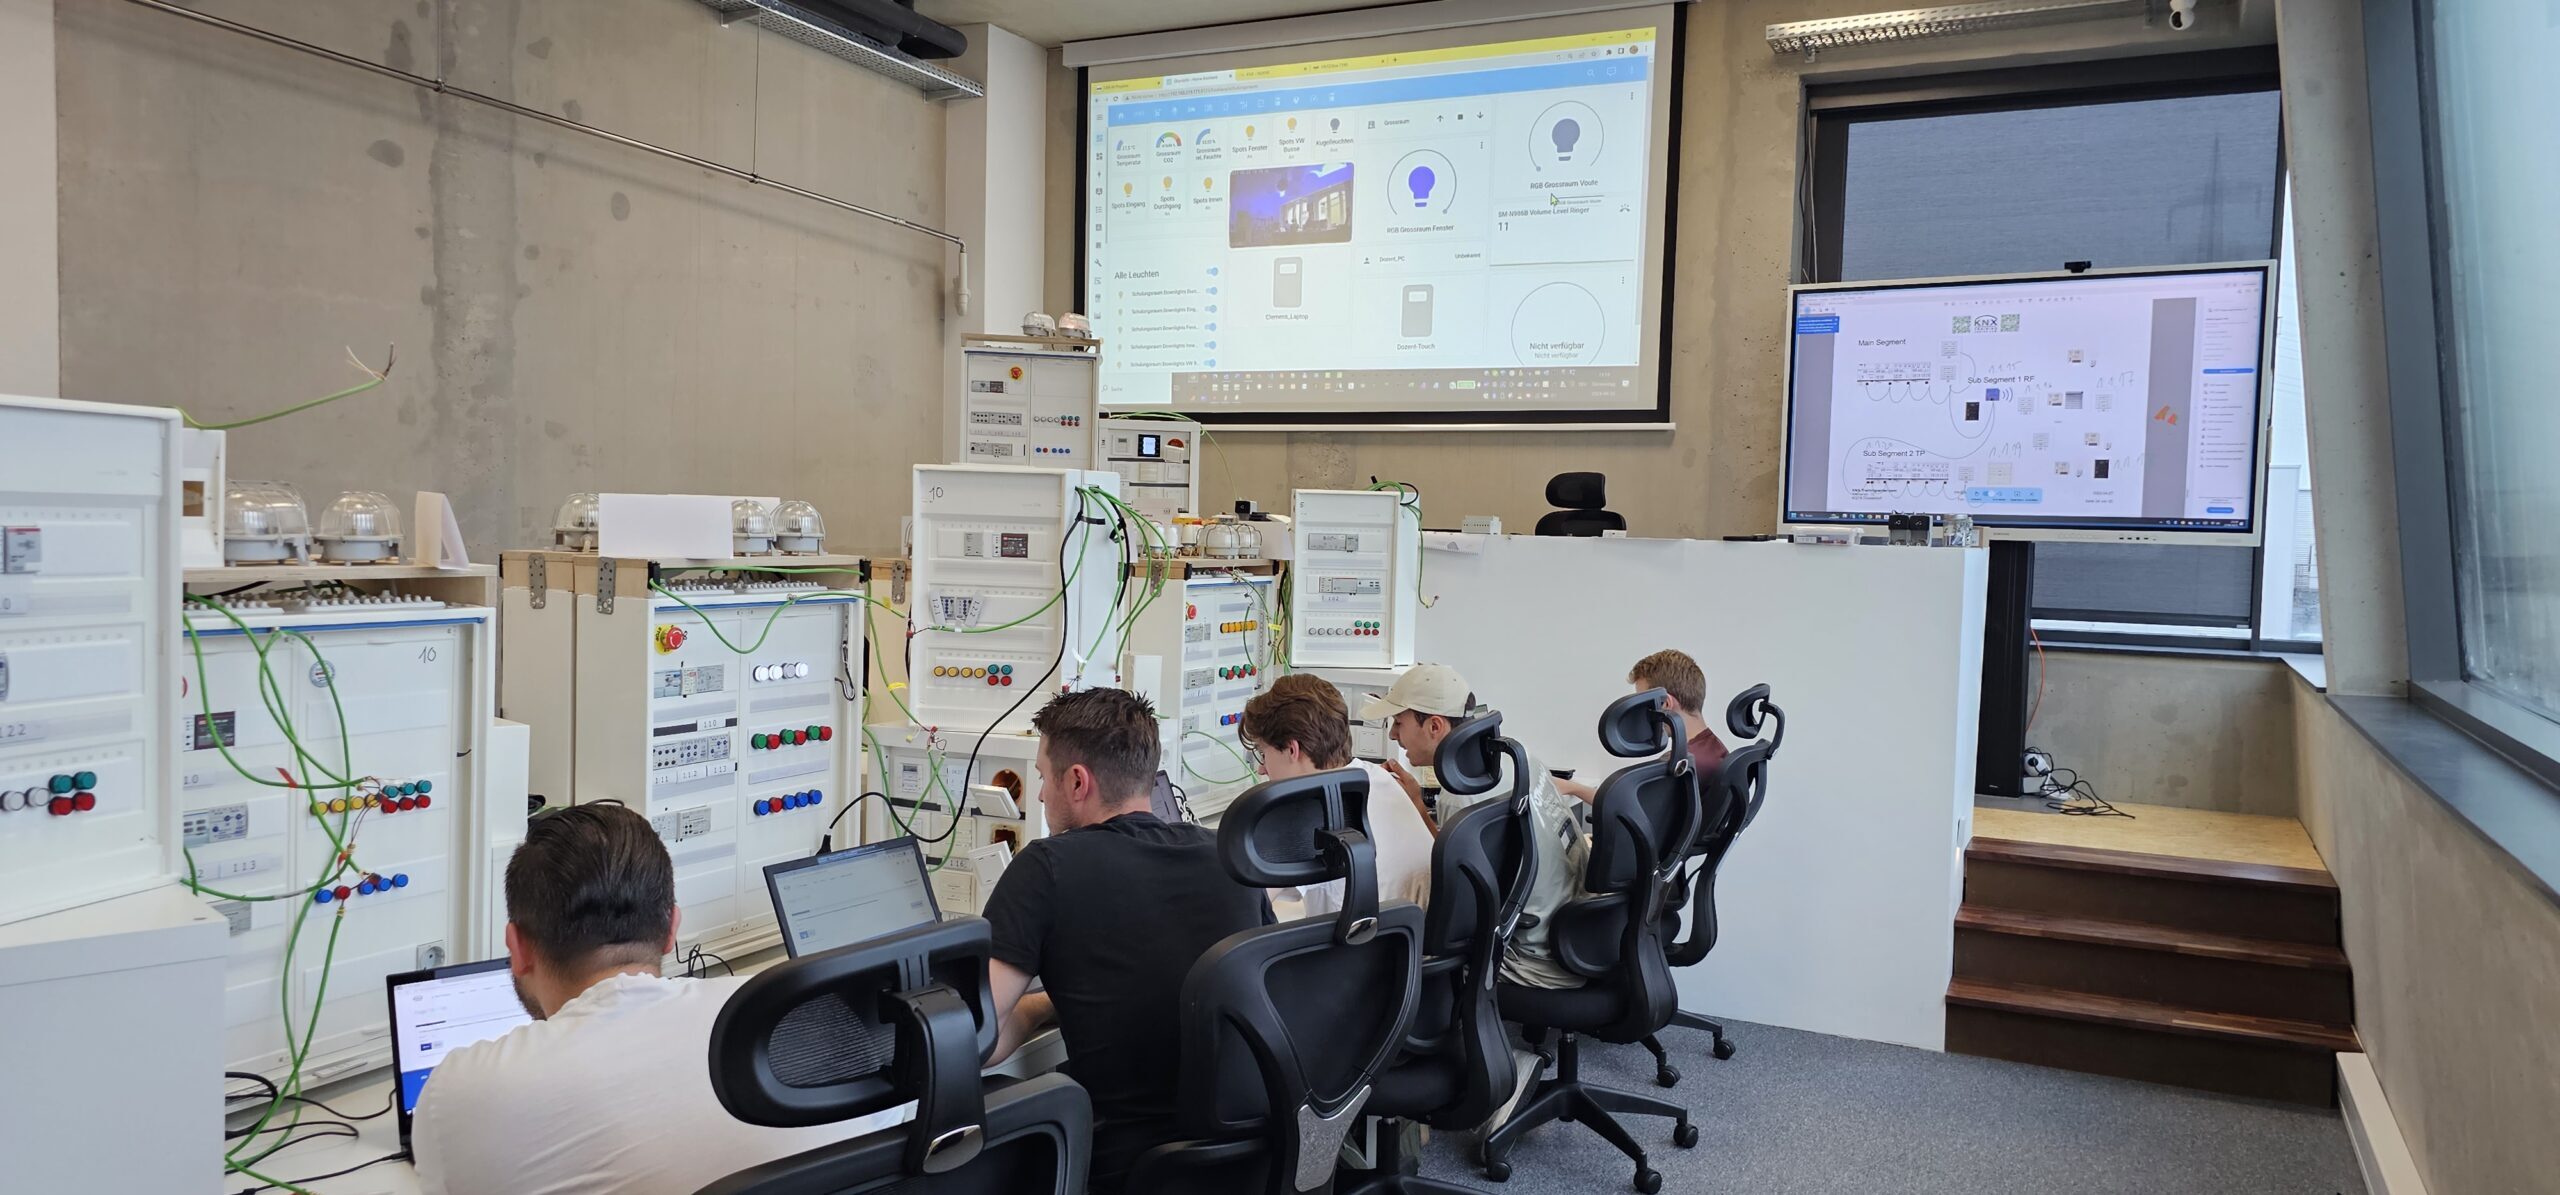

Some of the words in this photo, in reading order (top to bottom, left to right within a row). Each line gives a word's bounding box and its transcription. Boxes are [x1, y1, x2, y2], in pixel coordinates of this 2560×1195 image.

[1498, 222, 1509, 231] 11
[1550, 342, 1584, 351] verfügbar
[1876, 339, 1906, 347] Segment
[1984, 376, 2015, 384] Segment
[1878, 450, 1907, 458] Segment
[929, 486, 944, 500] 10
[418, 646, 437, 663] 10
